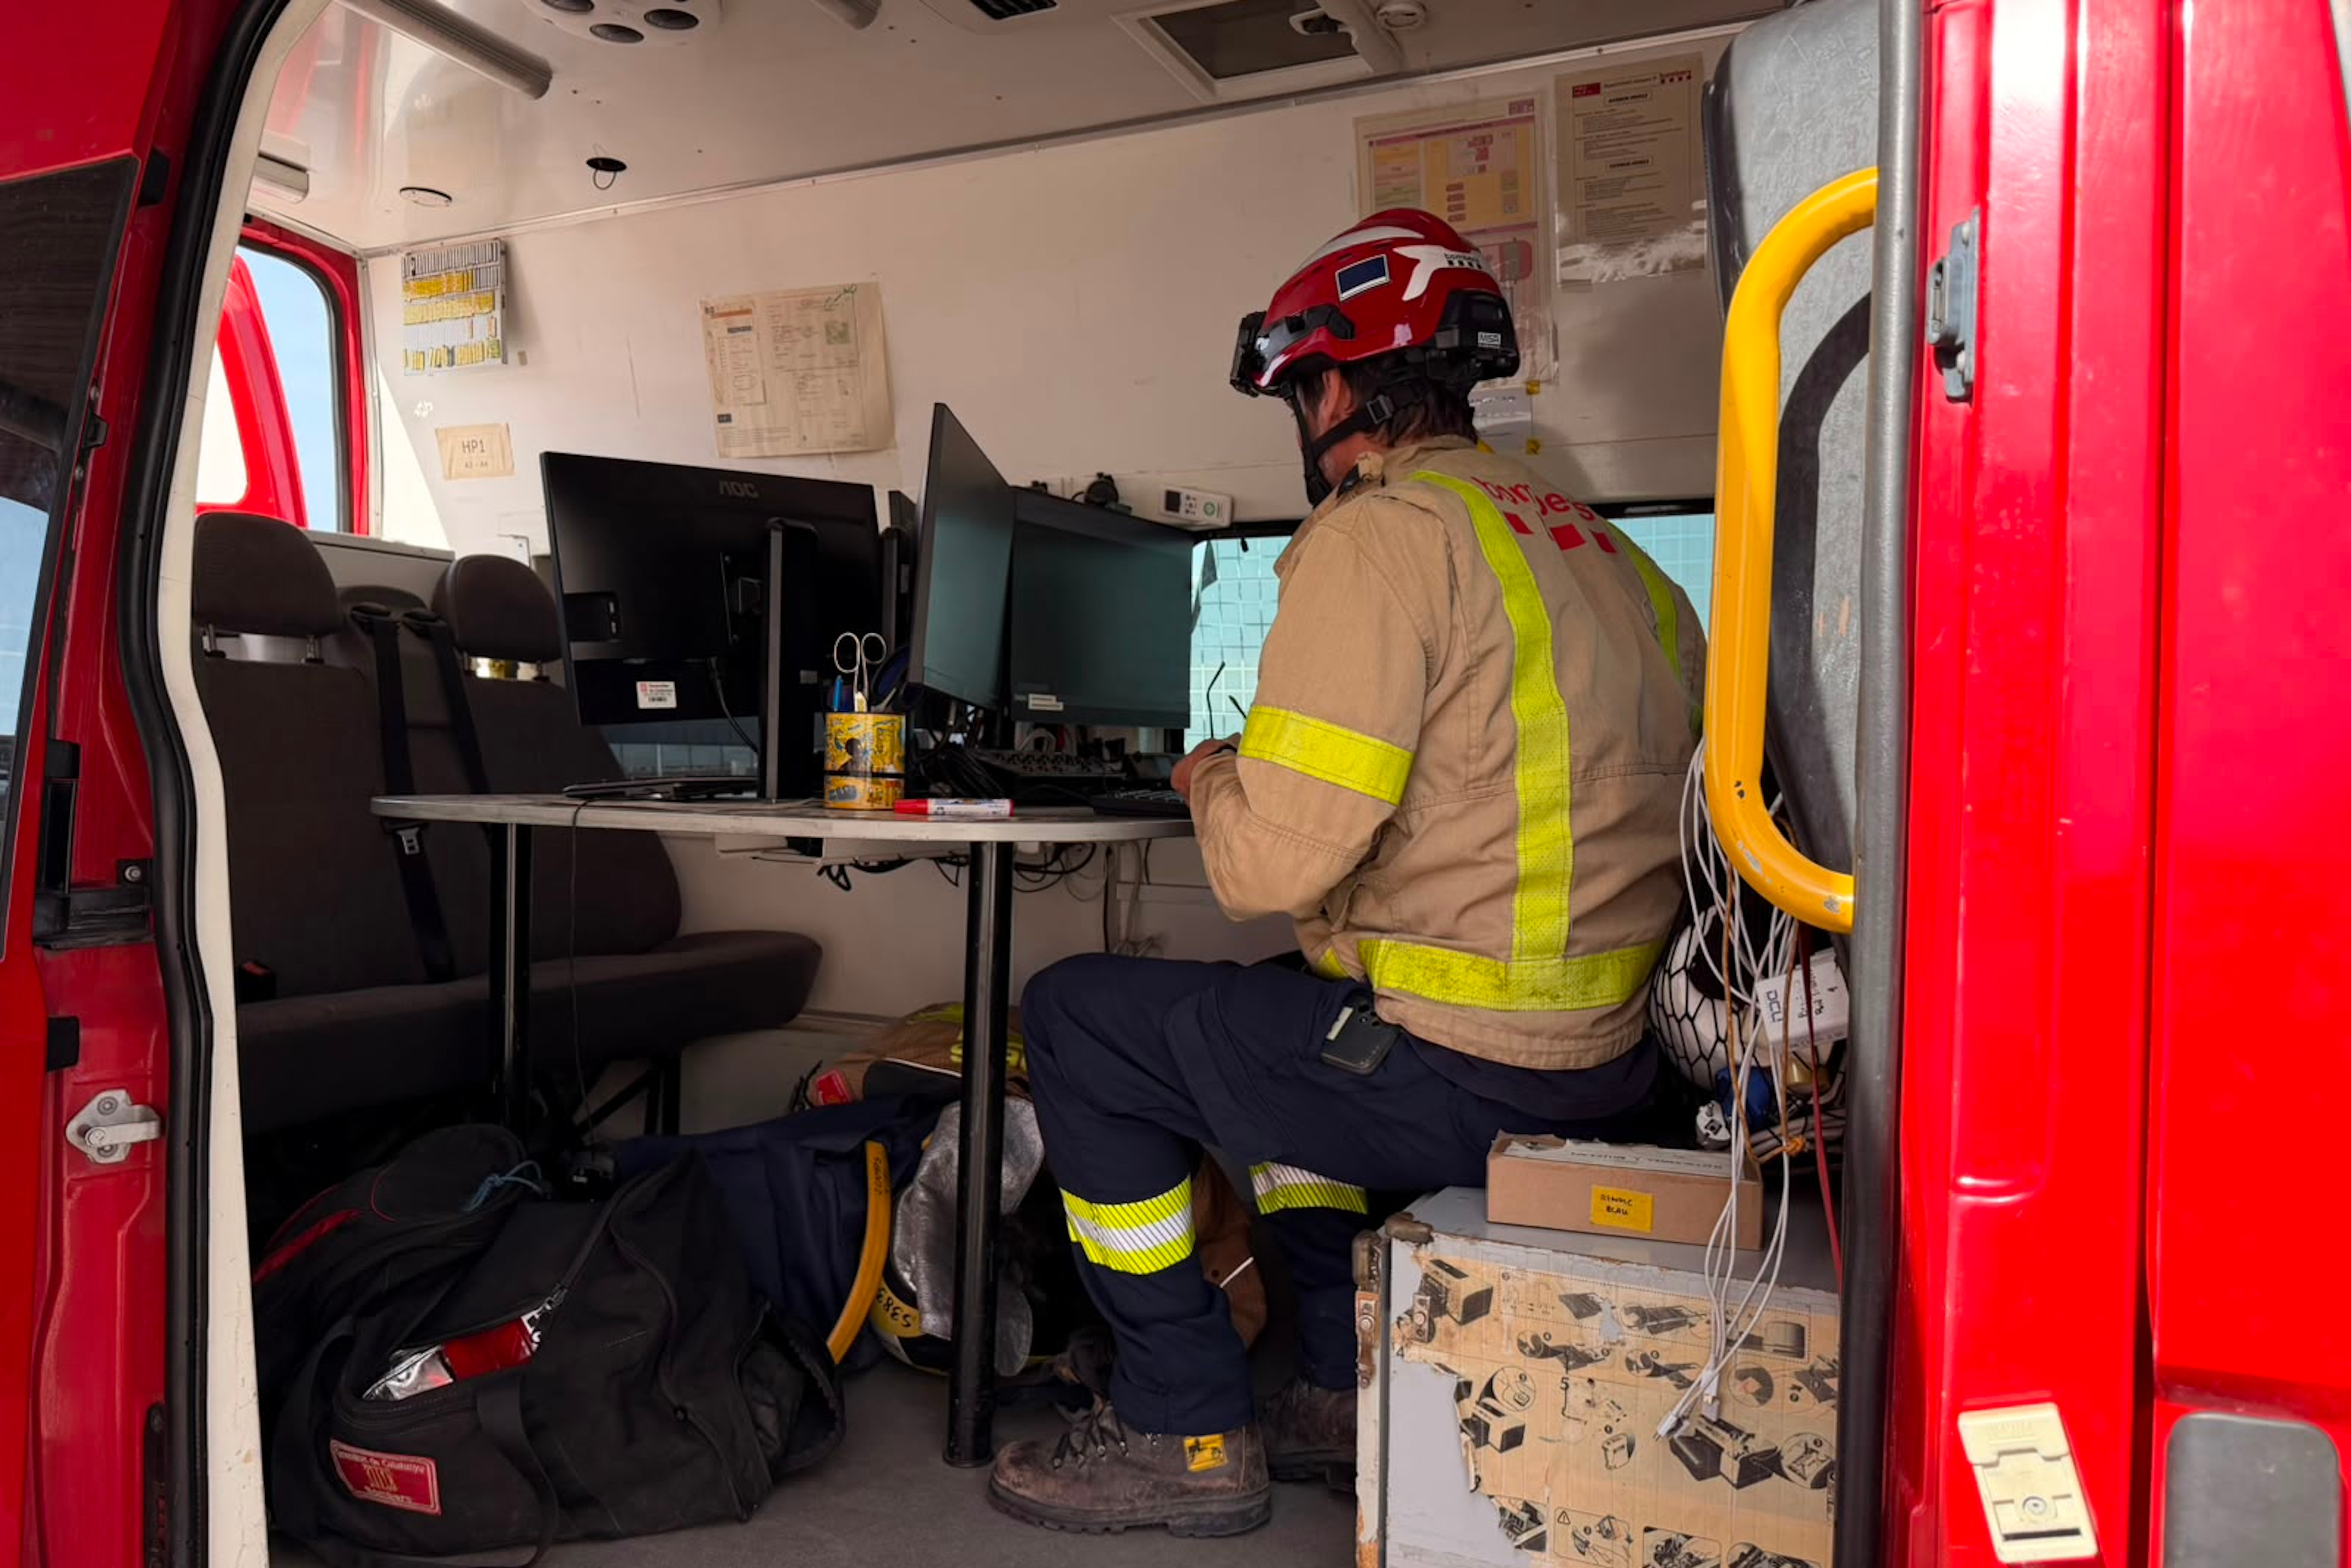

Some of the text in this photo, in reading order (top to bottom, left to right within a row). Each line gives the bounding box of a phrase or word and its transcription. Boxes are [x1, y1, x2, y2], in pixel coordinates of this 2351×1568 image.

[461, 439, 485, 454] HP1
[719, 480, 760, 499] AOC
[1560, 1377, 1569, 1390] 5
